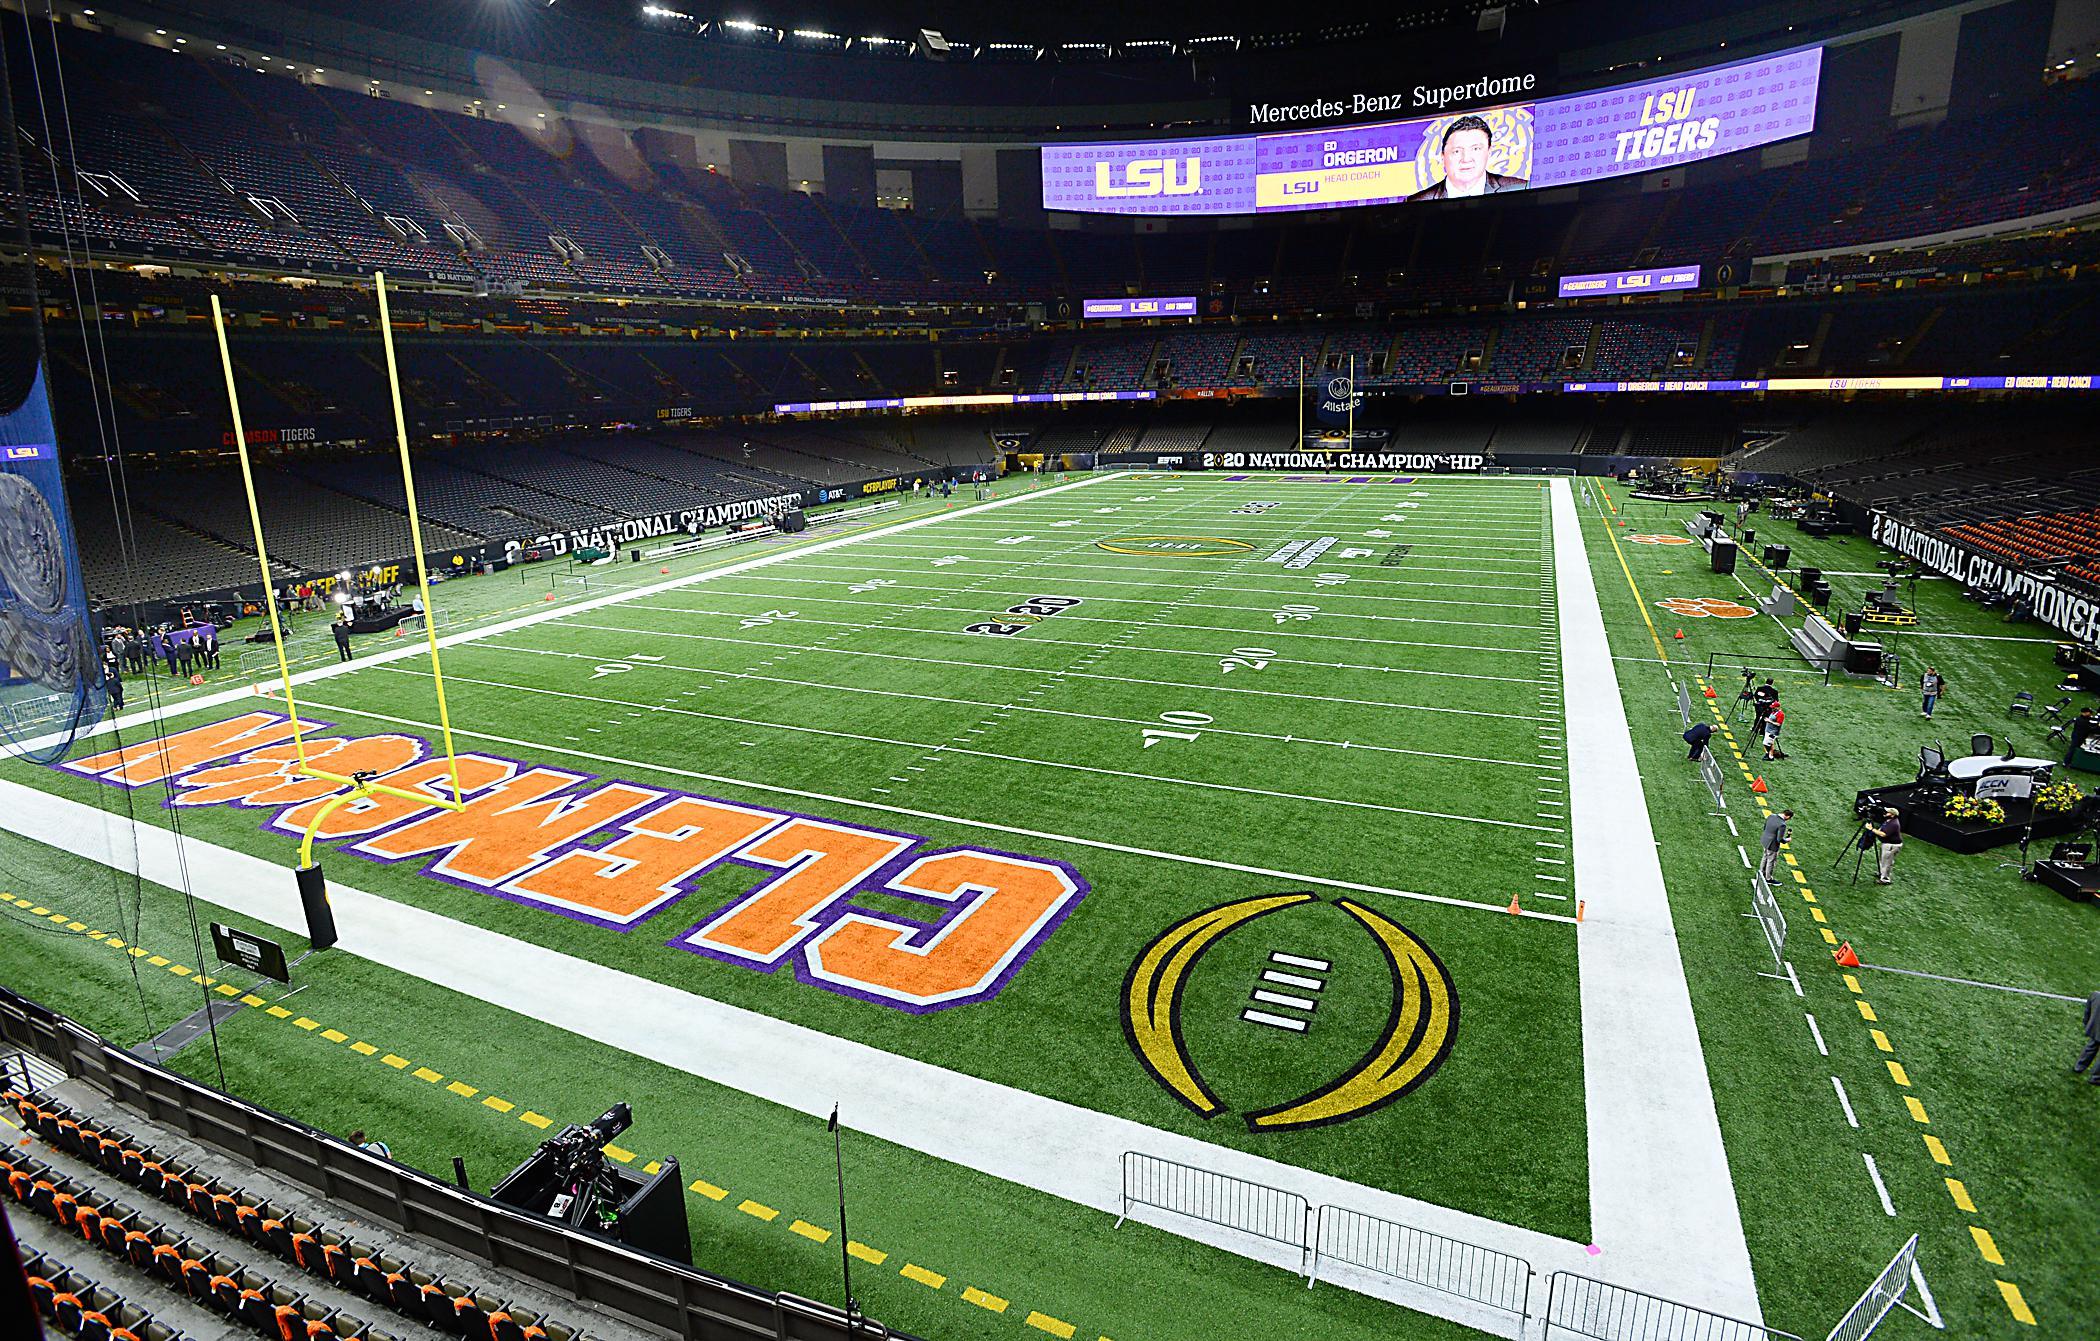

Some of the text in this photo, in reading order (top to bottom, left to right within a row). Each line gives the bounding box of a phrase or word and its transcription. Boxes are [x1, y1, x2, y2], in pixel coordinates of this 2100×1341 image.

[1250, 73, 1536, 124] Mercedes-Benz Superdome
[1639, 87, 1697, 126] LSU
[1324, 140, 1338, 152] ED
[1614, 117, 1721, 163] TIGERS
[1323, 146, 1399, 168] ORGERON
[1095, 156, 1202, 198] LSU
[1324, 170, 1381, 183] HEAD COACH
[1283, 180, 1320, 195] LSU
[1616, 275, 1651, 289] LSU
[1130, 302, 1158, 313] LSU
[1683, 381, 1708, 391] COACH
[1829, 379, 1848, 388] LSU
[657, 408, 692, 419] LSU TIGERS
[223, 428, 316, 445] CLMSON TIGERS
[6, 447, 39, 459] LSU
[1157, 456, 1183, 465] ESPN
[1248, 453, 1337, 468] NATIONAL
[863, 478, 897, 494] #CFBPLAYOFF
[827, 488, 845, 500] AT&T
[1898, 525, 1966, 582] NATIONAL
[593, 652, 667, 675] 10
[1218, 647, 1278, 672] 20
[1141, 710, 1215, 743] 10
